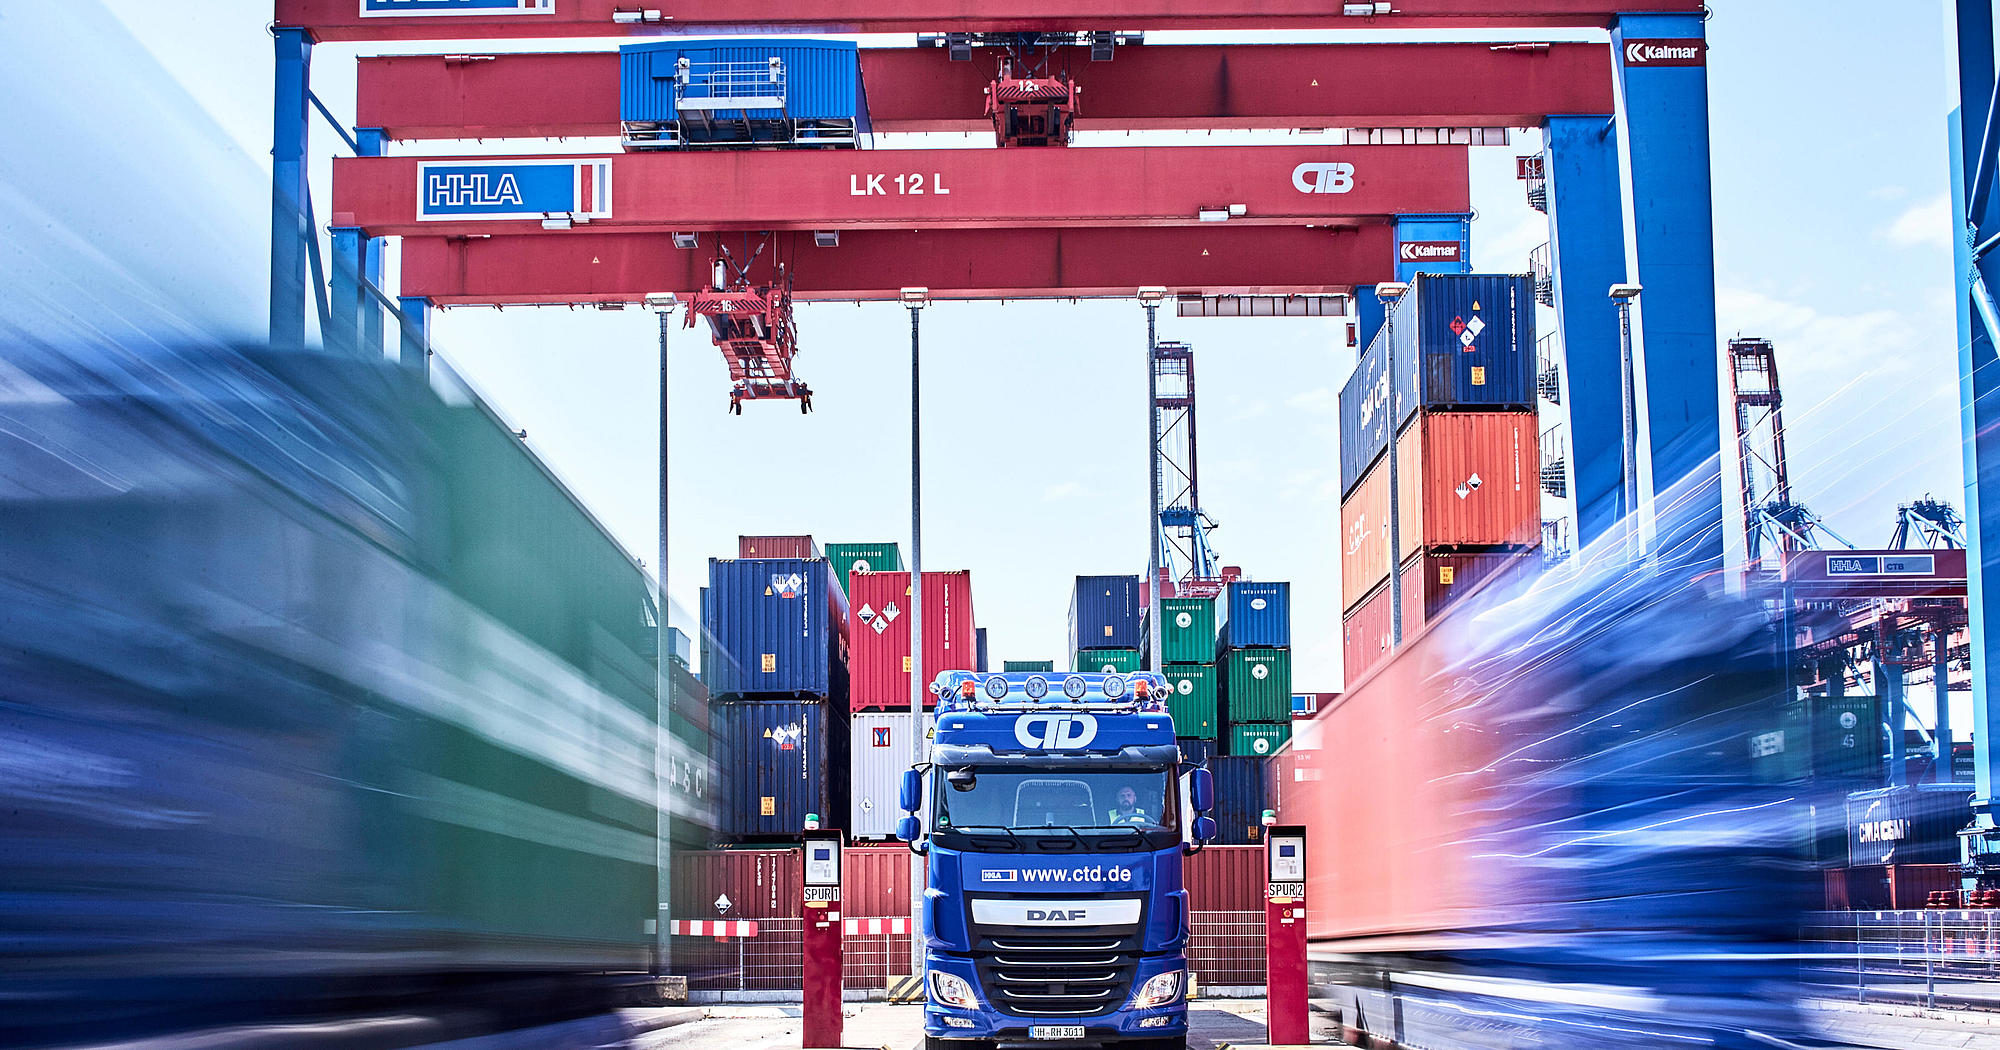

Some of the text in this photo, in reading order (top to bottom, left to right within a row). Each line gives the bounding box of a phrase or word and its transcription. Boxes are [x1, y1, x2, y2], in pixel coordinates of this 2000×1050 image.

[1644, 45, 1698, 59] Kalmar
[1292, 161, 1356, 195] CTB
[428, 173, 524, 207] HHLA
[849, 174, 950, 196] LK 12 L
[1414, 245, 1458, 257] Kalmar
[1831, 560, 1905, 572] HHLA CTB
[1021, 865, 1132, 882] www.ctd.de
[804, 887, 838, 900] SPUR 1
[1269, 884, 1303, 896] SPUR 2
[1026, 910, 1087, 921] DAF
[1063, 1027, 1084, 1037] 3011
